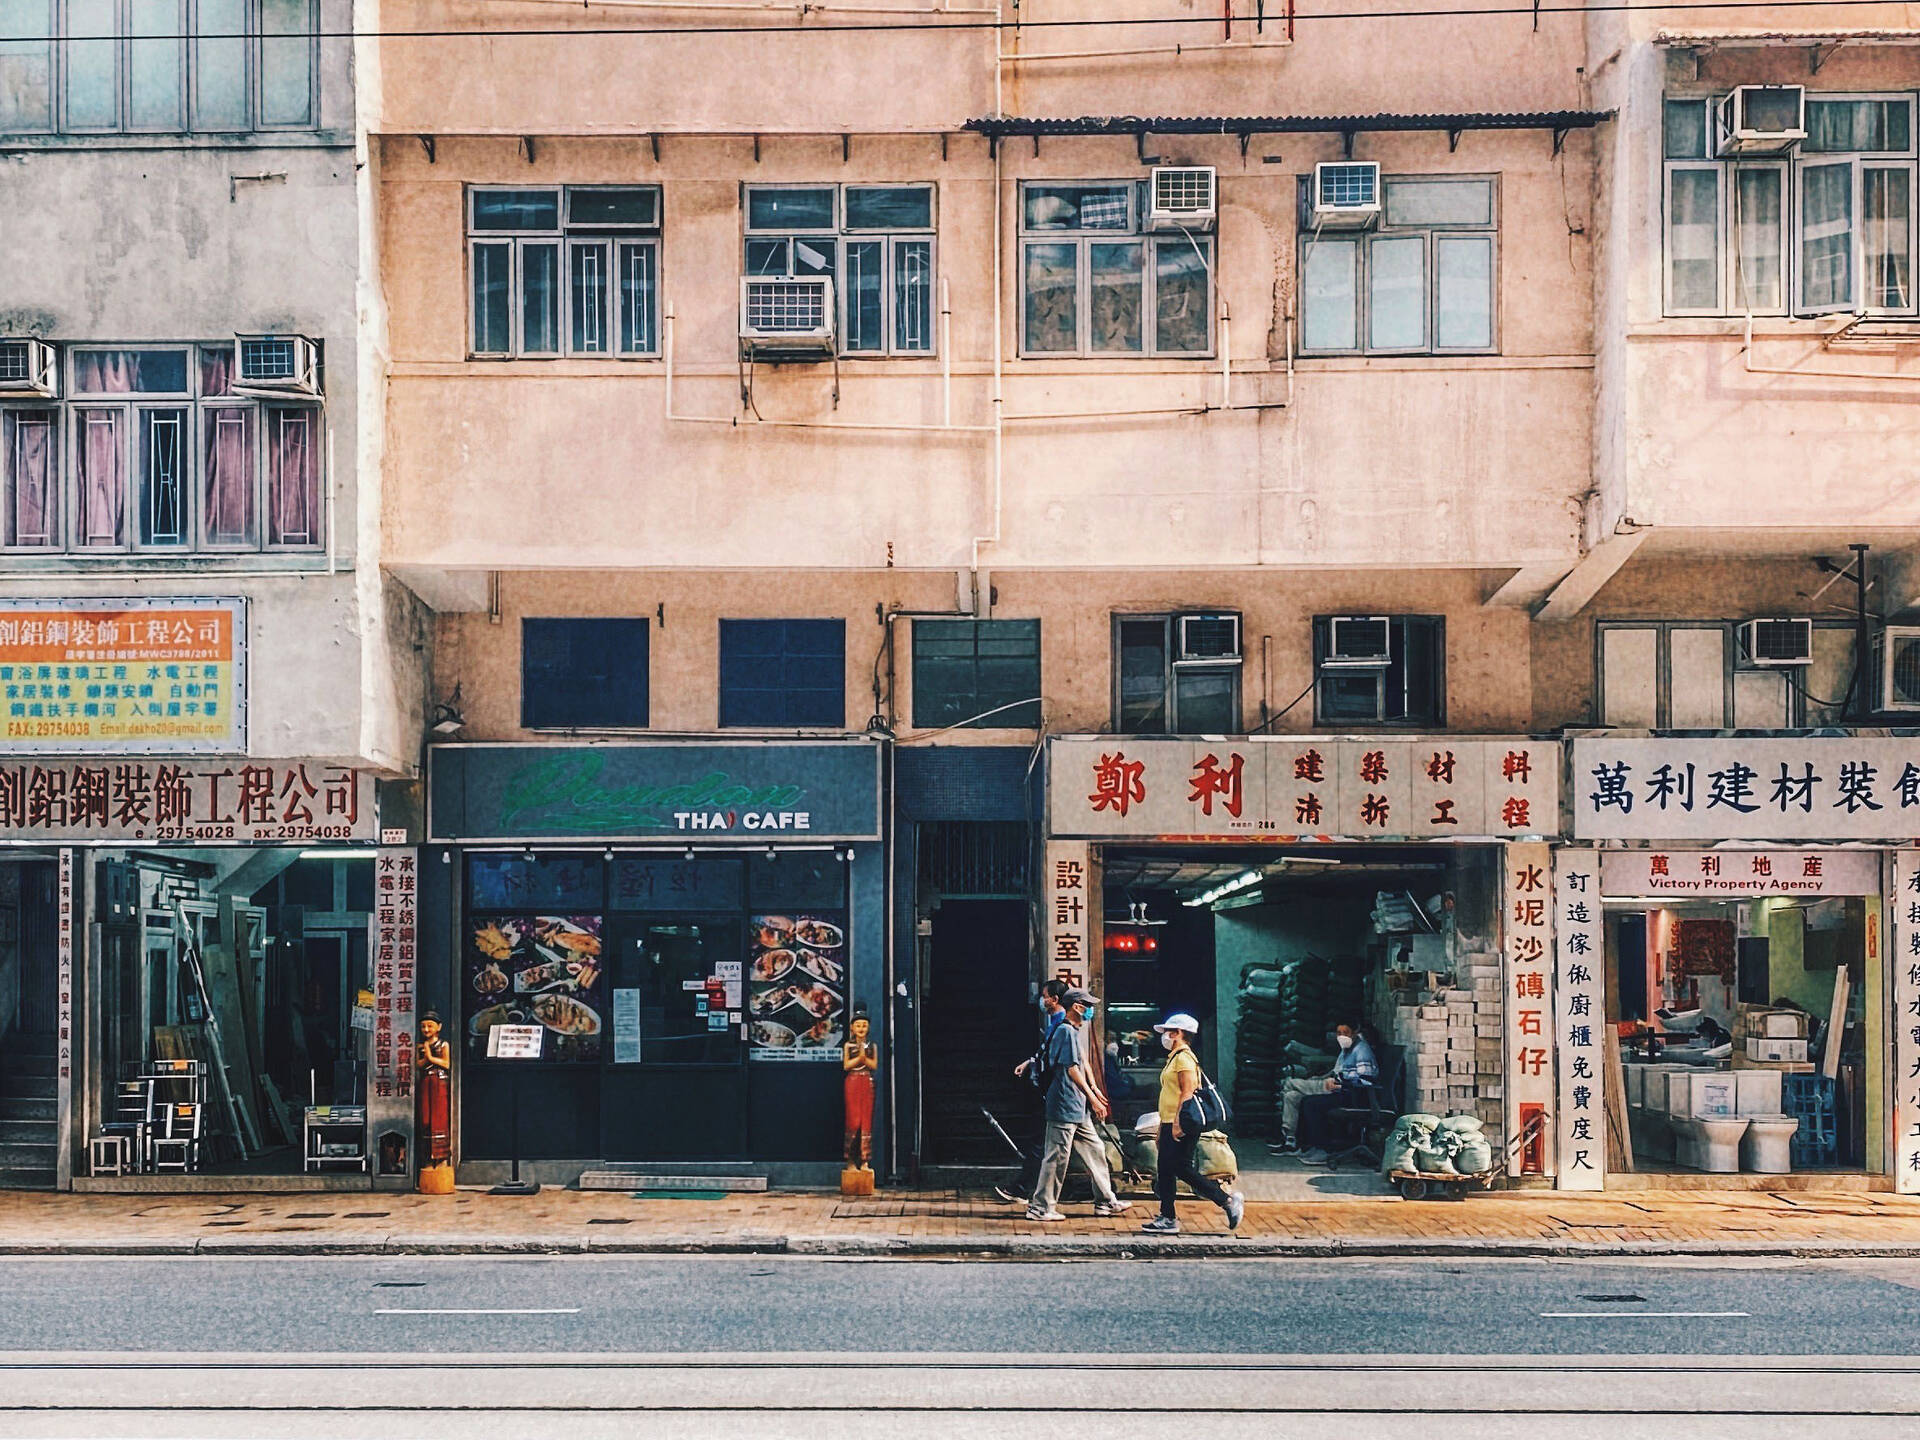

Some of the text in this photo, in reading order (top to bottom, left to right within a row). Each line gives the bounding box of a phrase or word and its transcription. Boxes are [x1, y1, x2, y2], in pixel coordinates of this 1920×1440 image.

[170, 684, 218, 699] 自動門
[37, 722, 90, 736] 29754038
[1294, 749, 1532, 784] 建築材料
[1088, 752, 1245, 817] 鄭利
[1295, 793, 1530, 829] 清拆工程
[743, 812, 810, 830] CAFE
[156, 827, 235, 839] 29754028
[278, 827, 352, 839] 29754038
[1649, 879, 1822, 891] Victory Property Agency
